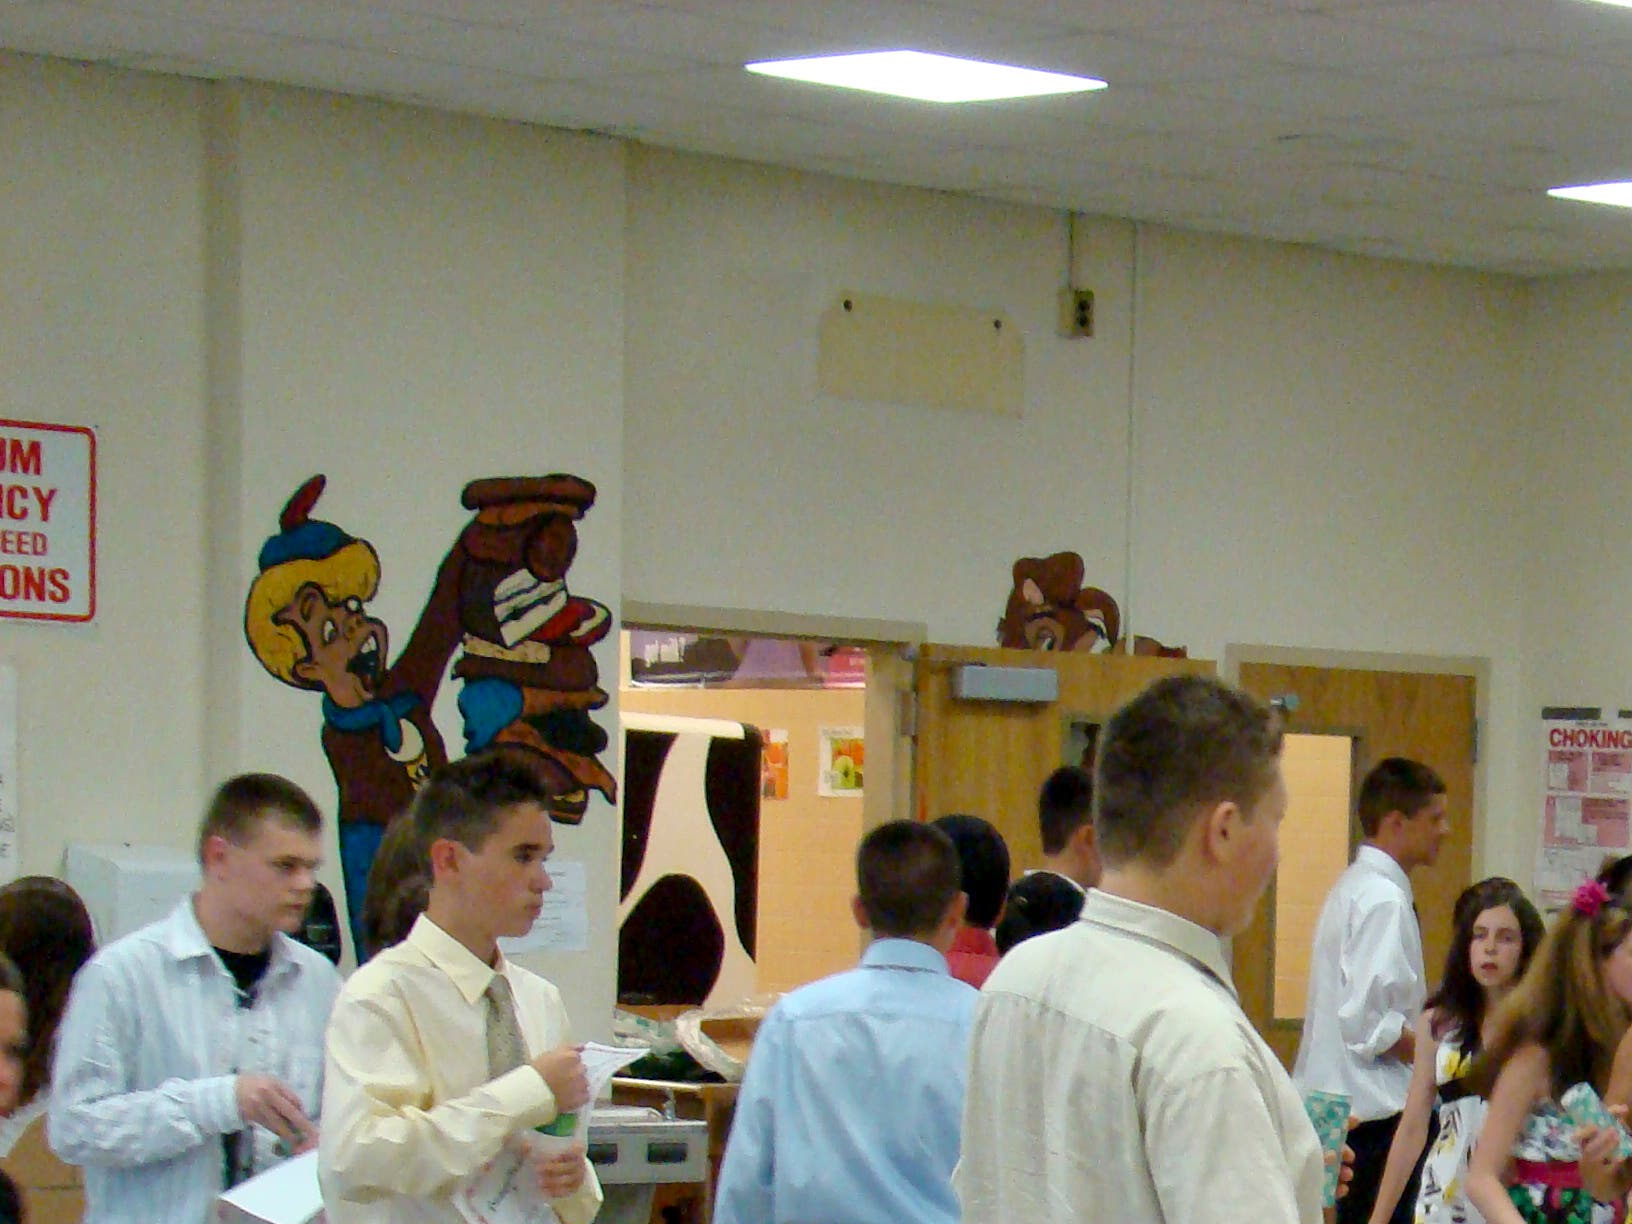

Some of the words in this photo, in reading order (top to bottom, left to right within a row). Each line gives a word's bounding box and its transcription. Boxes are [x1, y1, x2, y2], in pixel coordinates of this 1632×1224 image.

[0, 484, 58, 522] CY
[0, 529, 48, 556] EED
[1549, 727, 1632, 749] CHOKING
